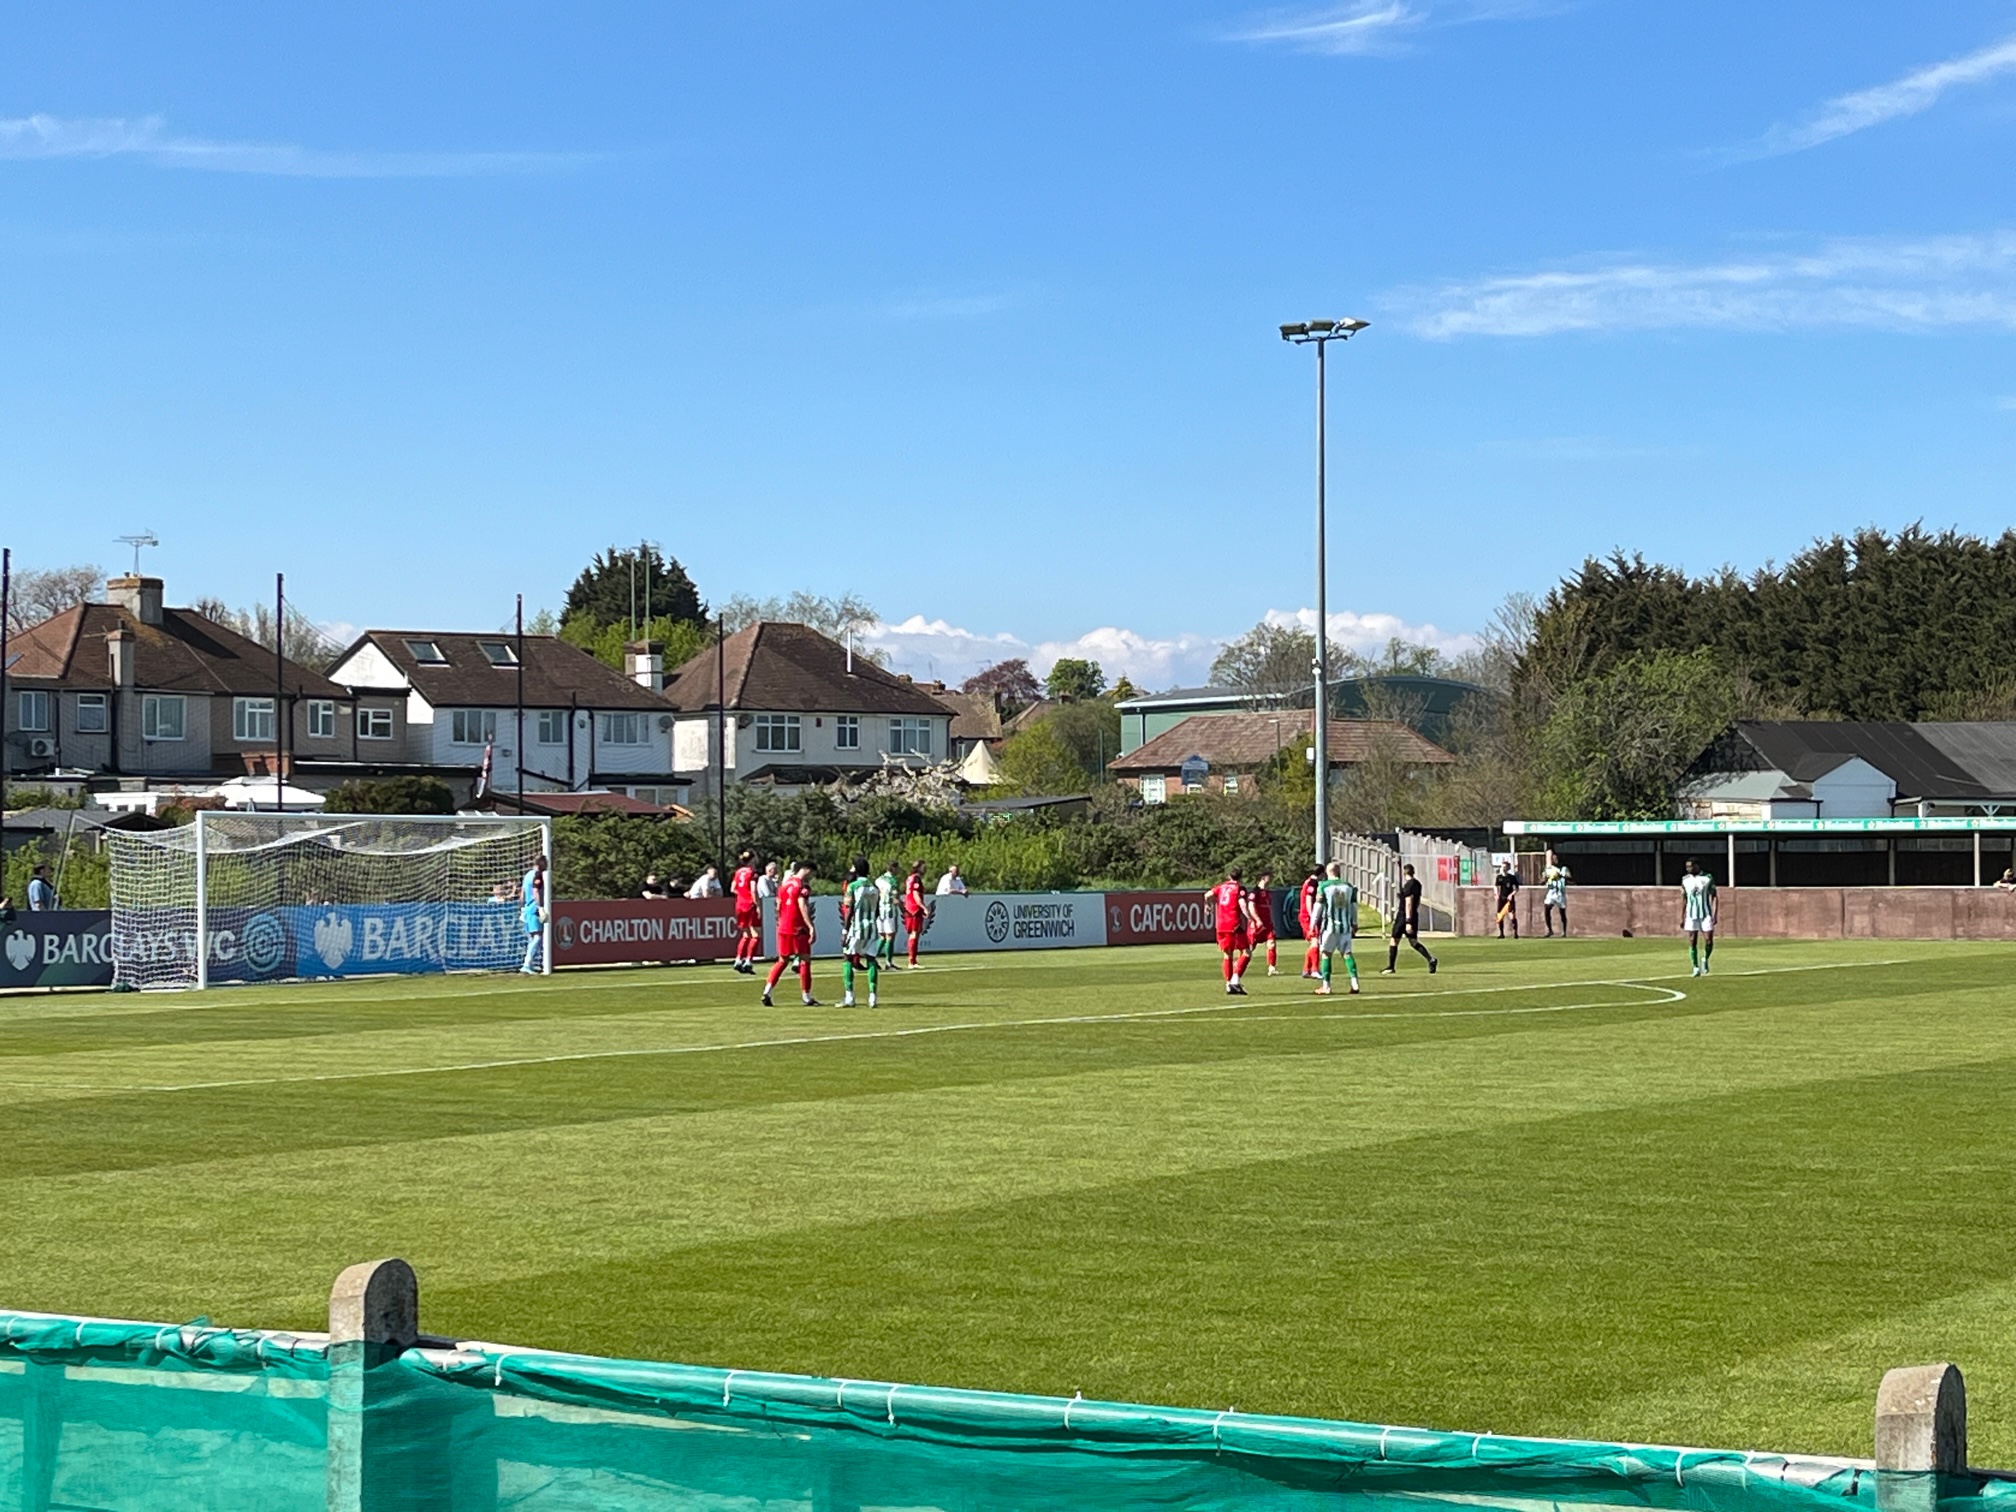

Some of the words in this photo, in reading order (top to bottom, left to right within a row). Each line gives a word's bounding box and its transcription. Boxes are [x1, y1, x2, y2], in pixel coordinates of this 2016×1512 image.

[1013, 904, 1062, 919] UNIVERSITY
[1062, 903, 1074, 917] OF
[1130, 903, 1213, 933] CAFC.CO.U
[579, 918, 663, 944] CHARLTON
[668, 916, 738, 940] ATHLETIC
[1013, 920, 1075, 939] GREENWICH
